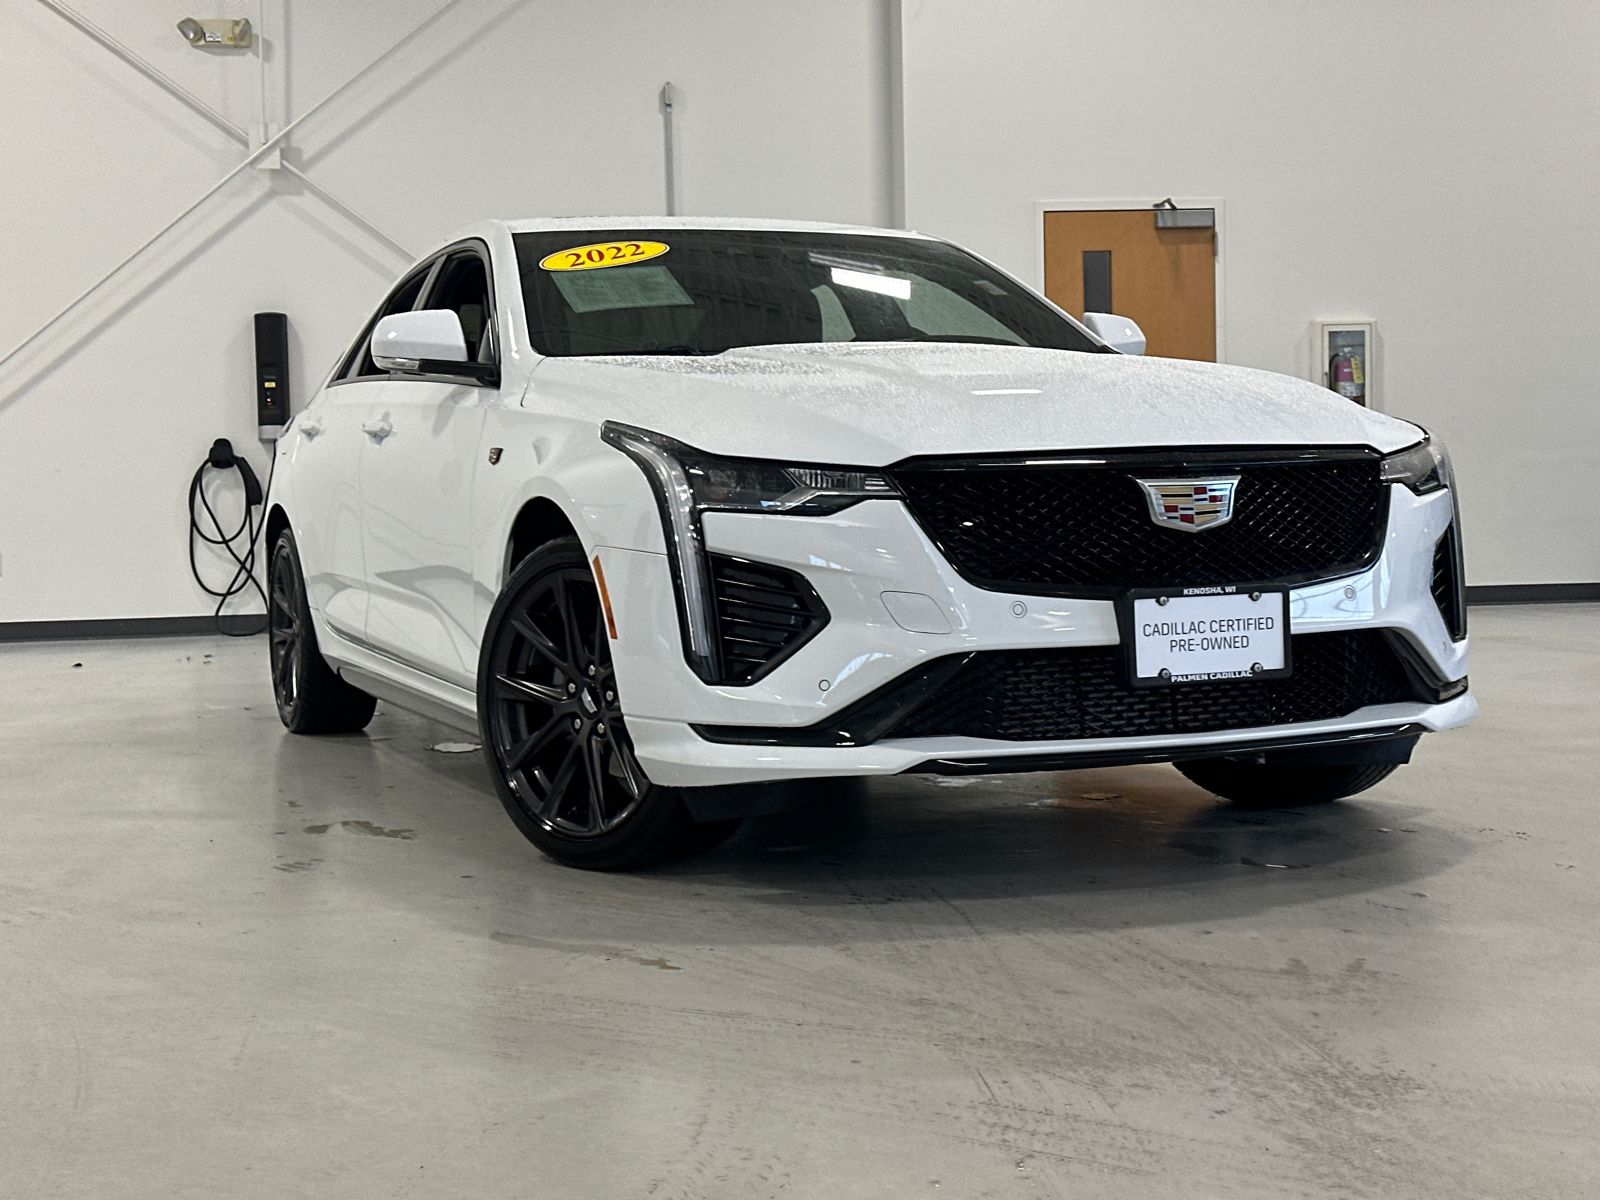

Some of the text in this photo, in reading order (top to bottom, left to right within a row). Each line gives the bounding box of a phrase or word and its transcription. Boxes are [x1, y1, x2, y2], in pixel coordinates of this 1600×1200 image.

[565, 243, 645, 267] 2022
[1183, 586, 1224, 595] KENOSHA,
[1143, 616, 1274, 637] CADILLAC CERTIFIED
[1170, 635, 1249, 652] PRE-OWNED
[1171, 670, 1253, 682] PALMEN CADILLAC
